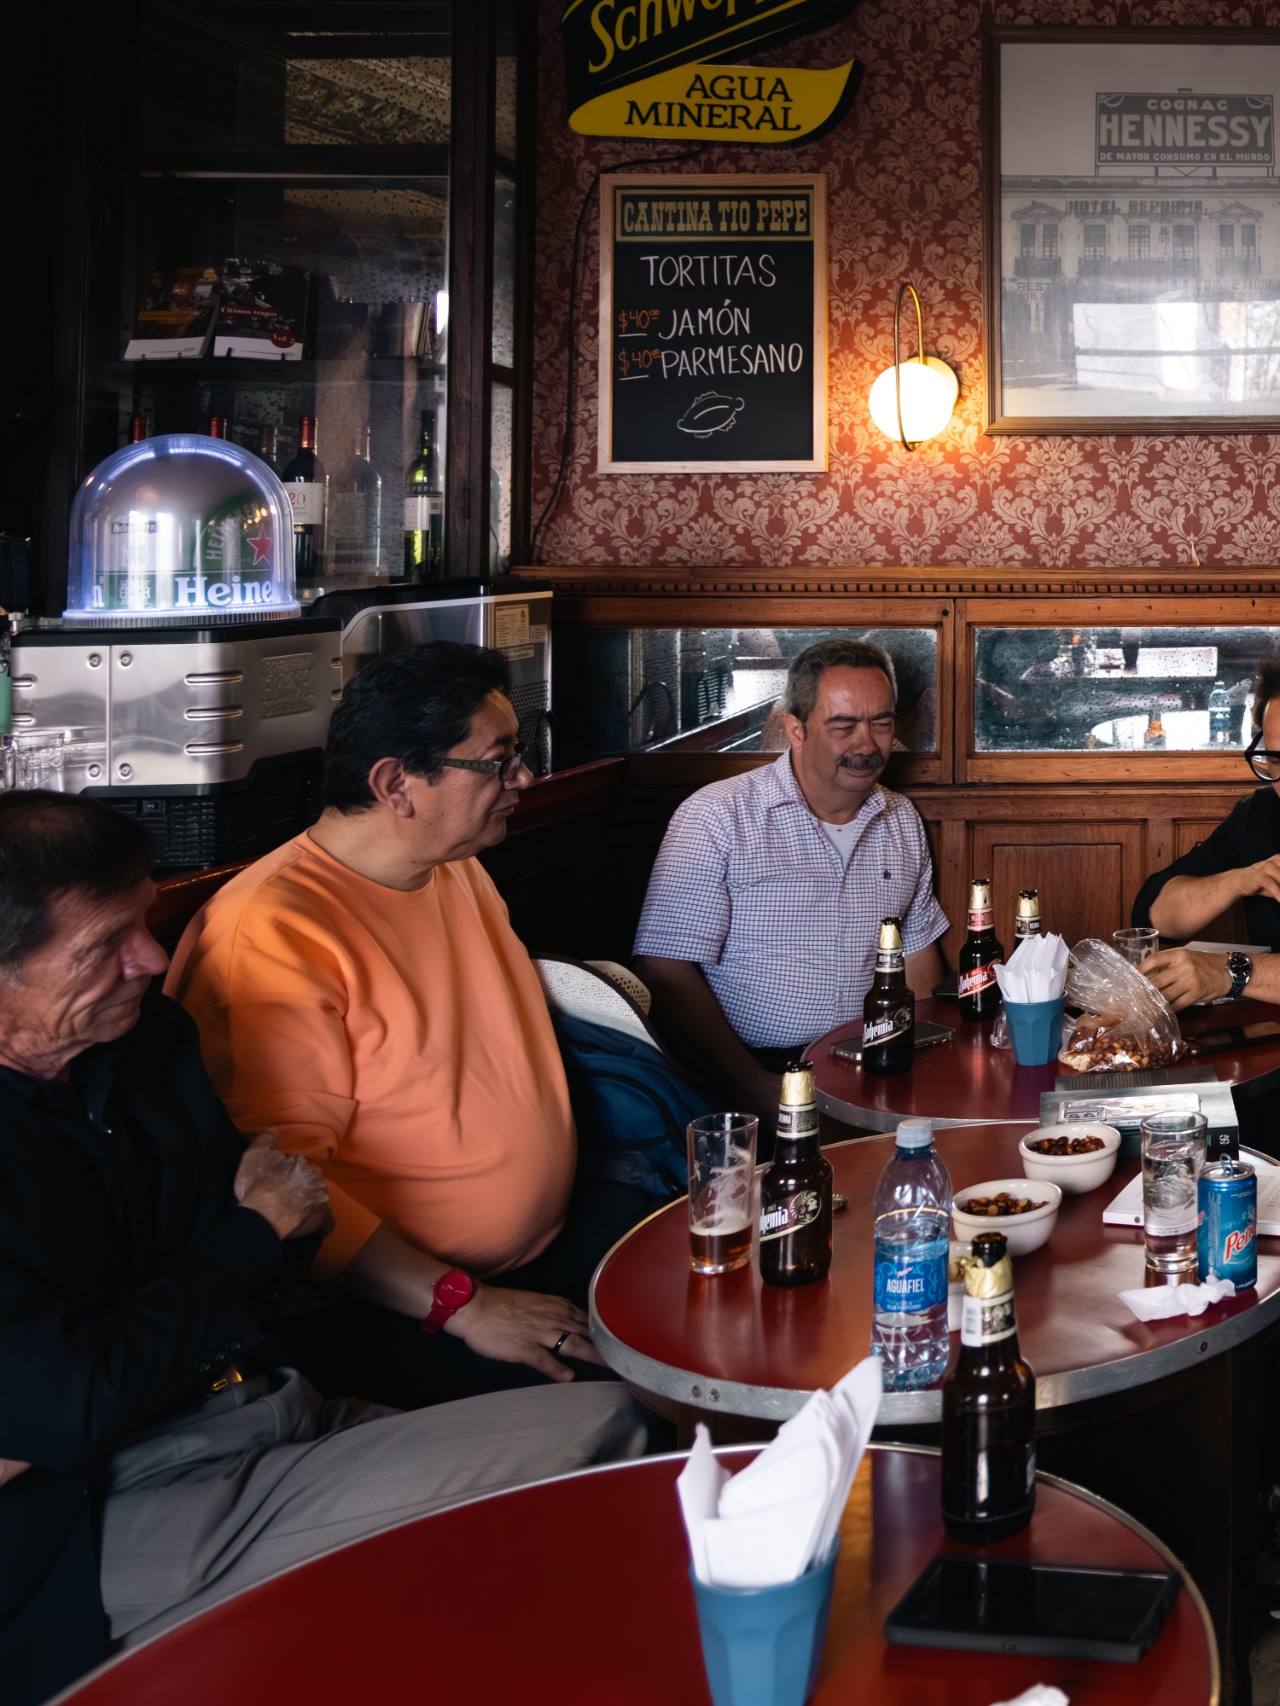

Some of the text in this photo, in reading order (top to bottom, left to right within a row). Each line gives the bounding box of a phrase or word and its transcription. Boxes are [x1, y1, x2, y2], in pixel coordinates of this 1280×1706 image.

[685, 74, 793, 103] AGUA
[624, 101, 802, 131] MINERAL
[1147, 99, 1228, 111] COGNAC
[1100, 113, 1271, 147] HENNESSY
[1100, 153, 1271, 162] DE MAYOR CONSUMO EN EL MUNDO
[624, 199, 808, 233] CANTINA TIO PEPE
[640, 254, 776, 287] TORTITAS
[658, 299, 751, 340] JAMÓN
[660, 343, 803, 379] PARMESANO
[886, 1278, 925, 1294] AGUAFIEL
